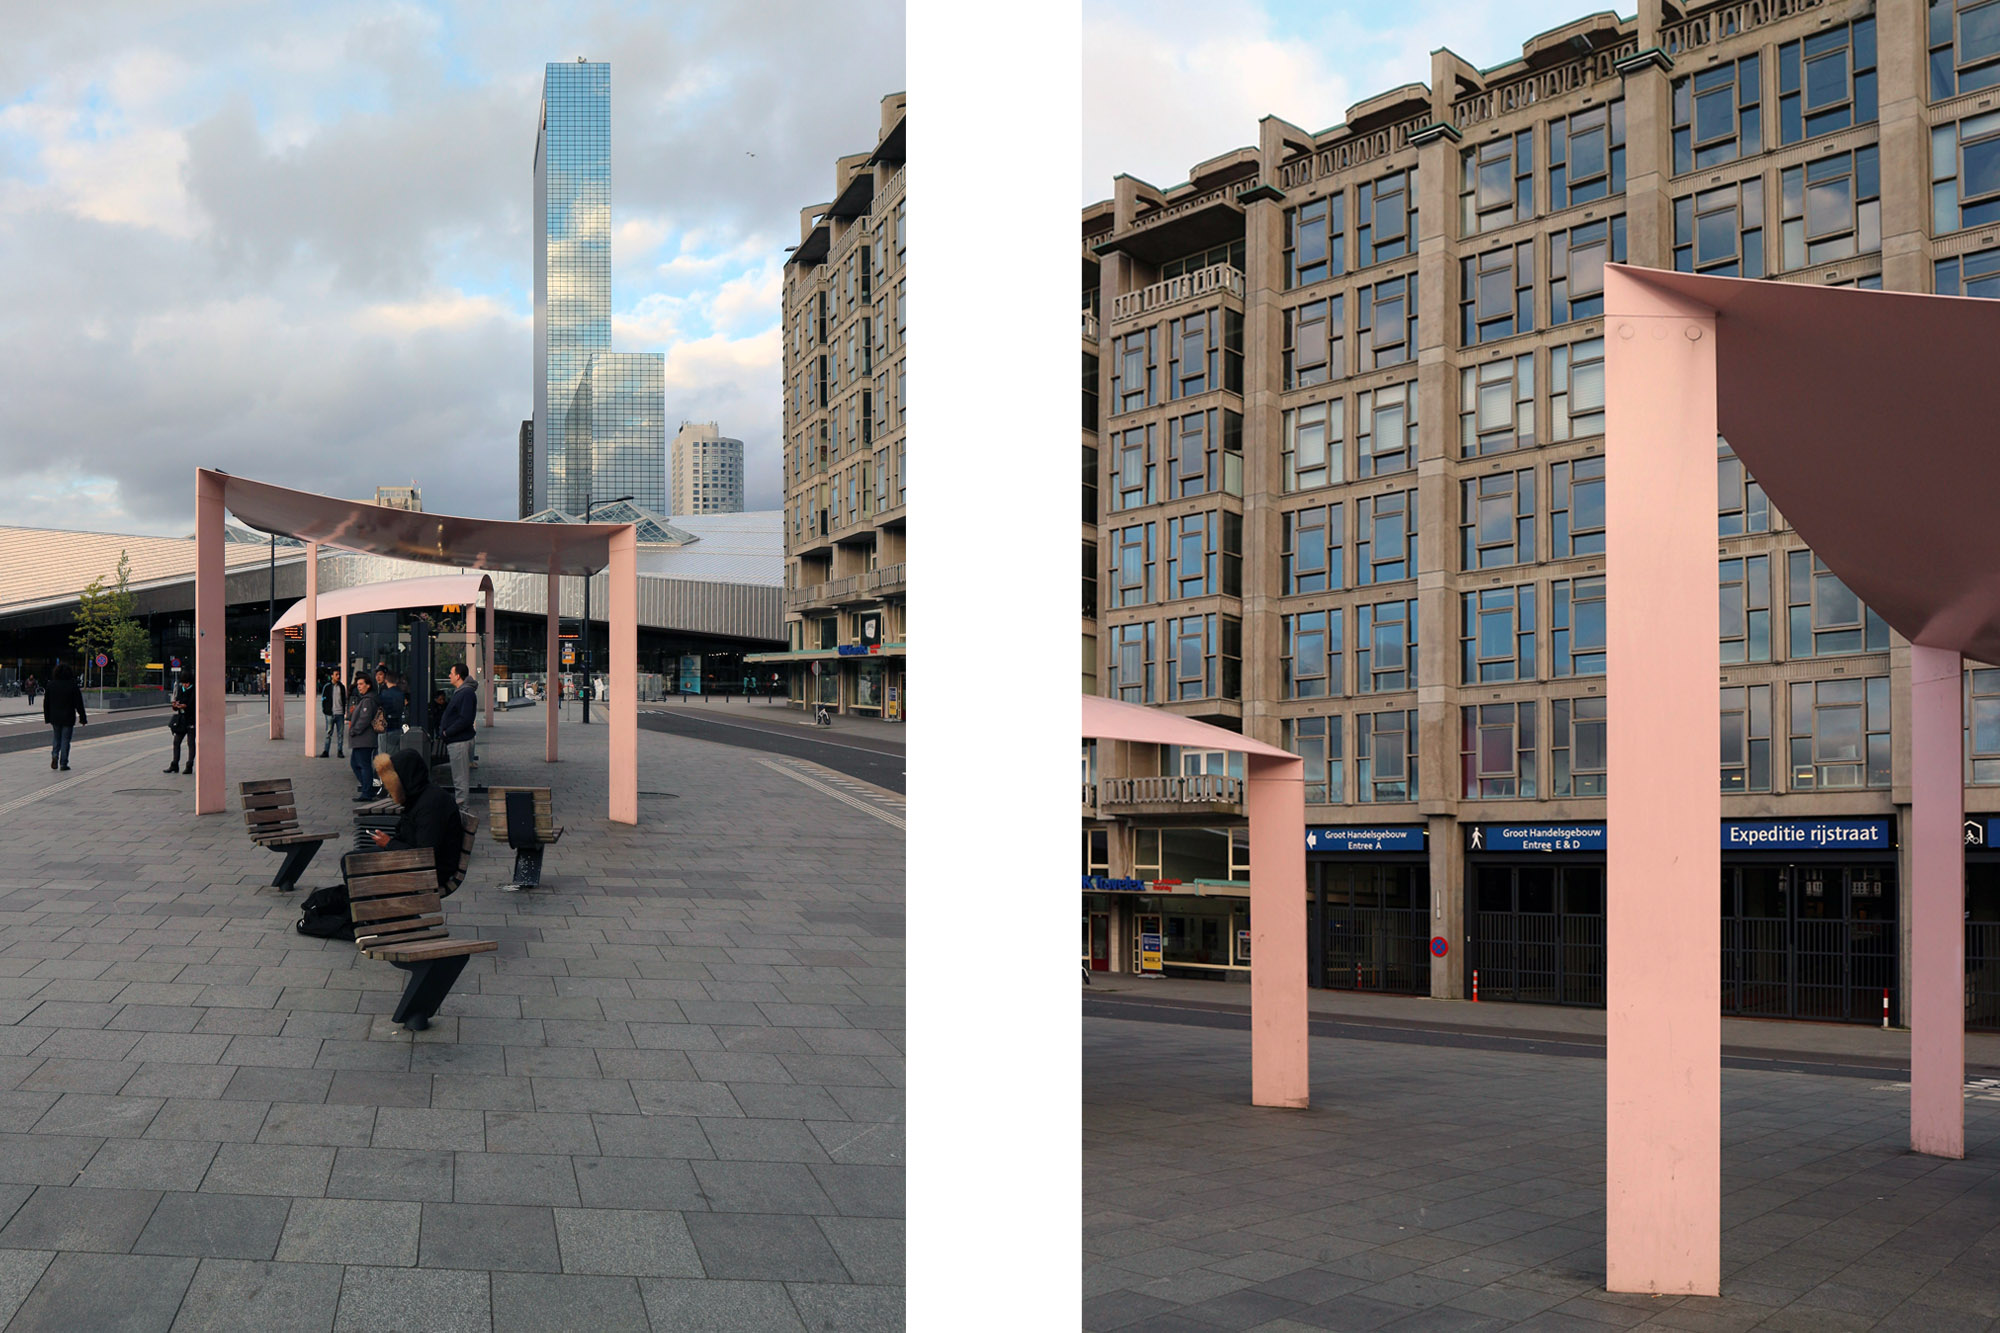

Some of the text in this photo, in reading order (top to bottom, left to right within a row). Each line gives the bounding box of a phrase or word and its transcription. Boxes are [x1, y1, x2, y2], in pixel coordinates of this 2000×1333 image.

[1324, 829, 1408, 841] Groot Handelsgebouw
[1502, 827, 1602, 840] Groot Handelsgebouw
[1730, 824, 1879, 846] Expeditie rijstraat
[1347, 841, 1382, 850] Entree A
[1522, 840, 1581, 849] Entree E & D
